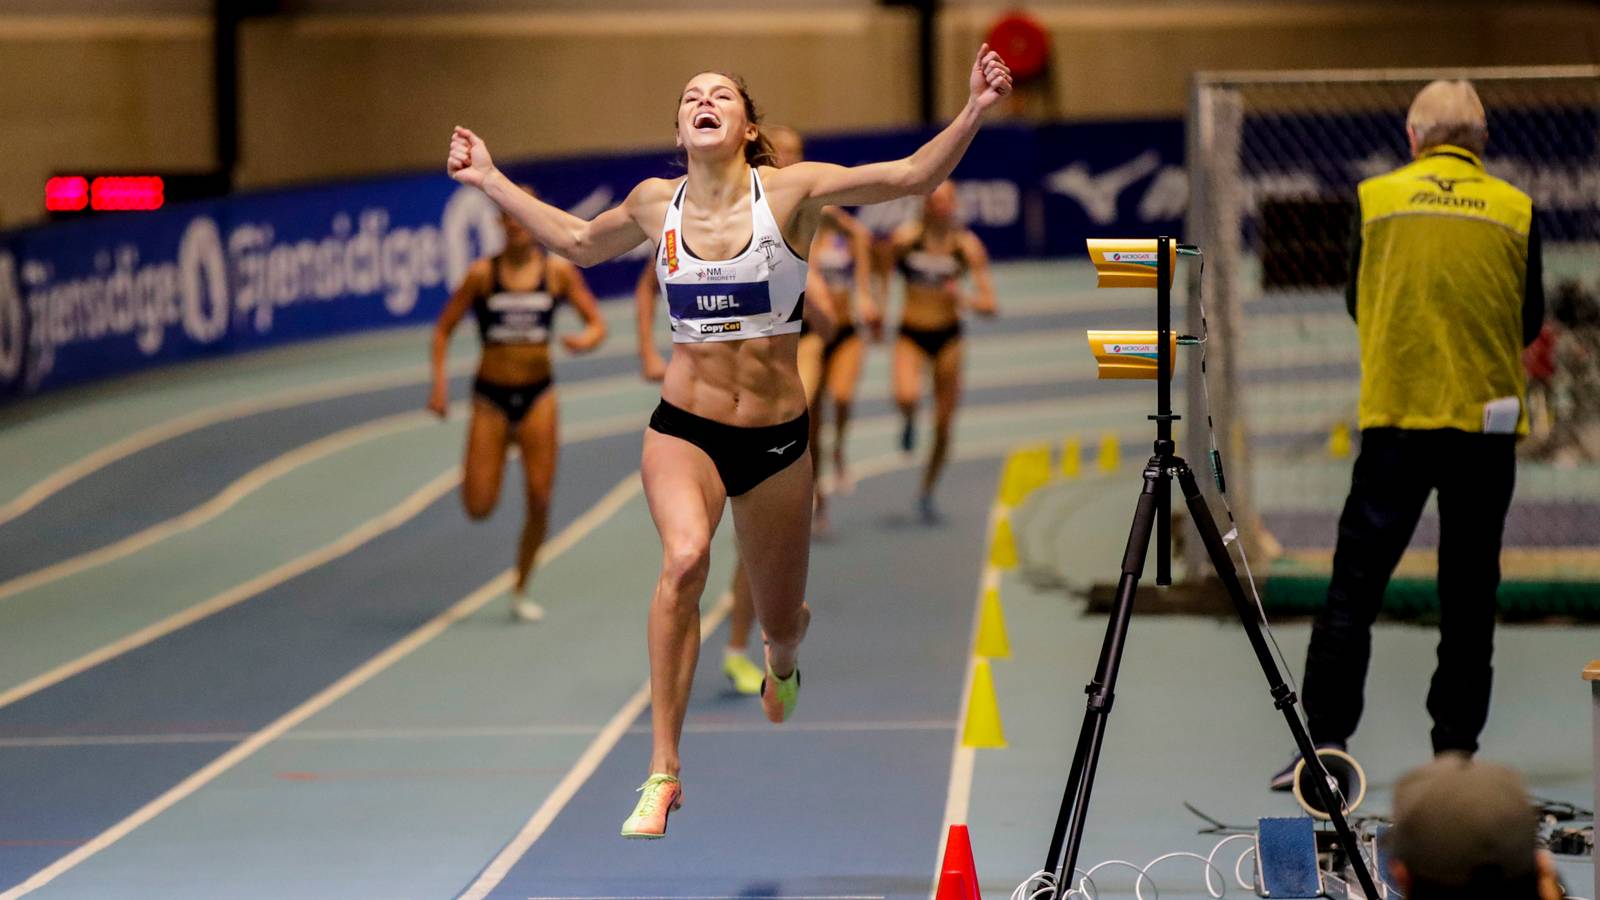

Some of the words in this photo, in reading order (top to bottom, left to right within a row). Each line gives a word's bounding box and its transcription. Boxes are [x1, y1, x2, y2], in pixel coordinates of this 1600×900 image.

[707, 267, 721, 275] NM
[696, 294, 740, 311] IUEL
[701, 322, 740, 332] CopyCat
